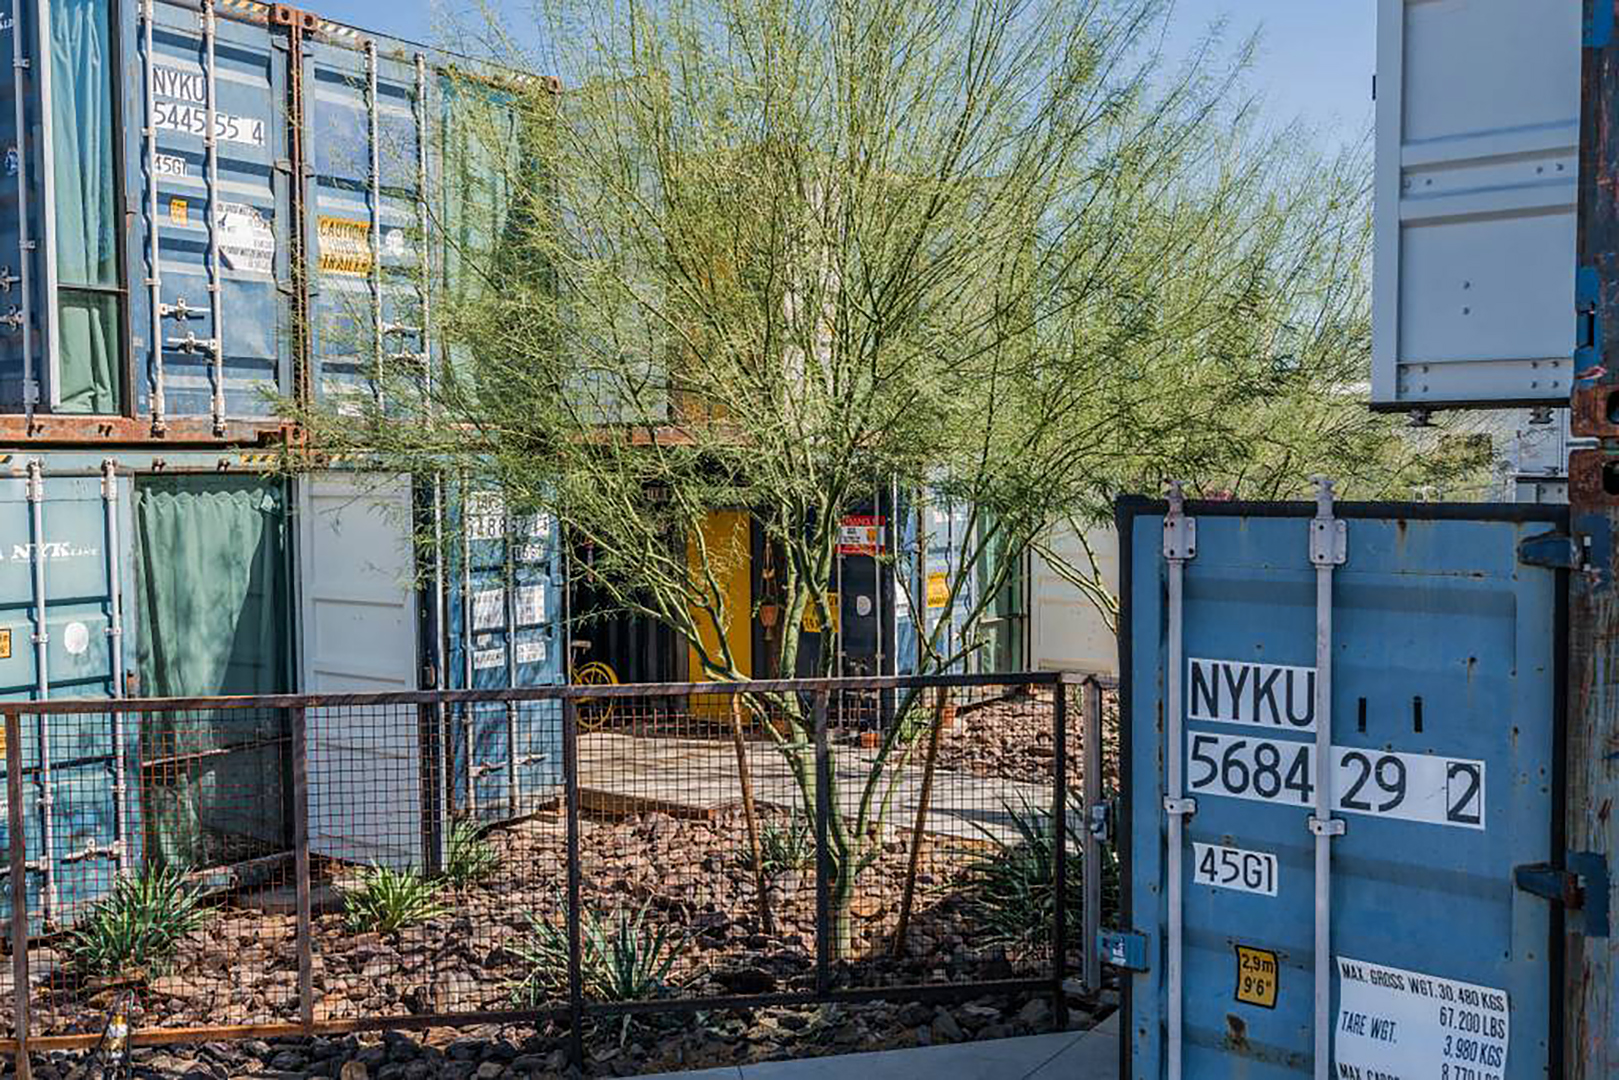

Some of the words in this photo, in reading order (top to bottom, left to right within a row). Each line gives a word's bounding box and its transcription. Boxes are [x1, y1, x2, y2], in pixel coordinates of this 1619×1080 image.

[153, 67, 205, 101] NYKU
[252, 121, 263, 146] 4
[1191, 661, 1316, 727] NYKU
[1446, 761, 1481, 825] 2
[1200, 848, 1272, 892] 45G1
[1341, 963, 1367, 983] MAX.
[1370, 968, 1405, 991] GROSS
[1481, 994, 1505, 1012] KGS
[1341, 1011, 1365, 1036] TARE
[1370, 1017, 1397, 1044] WGT.
[1443, 1035, 1478, 1062] 3.980
[1479, 1044, 1504, 1068] KGS
[1439, 1006, 1480, 1034] 67.200
[1482, 1014, 1506, 1039] LBS
